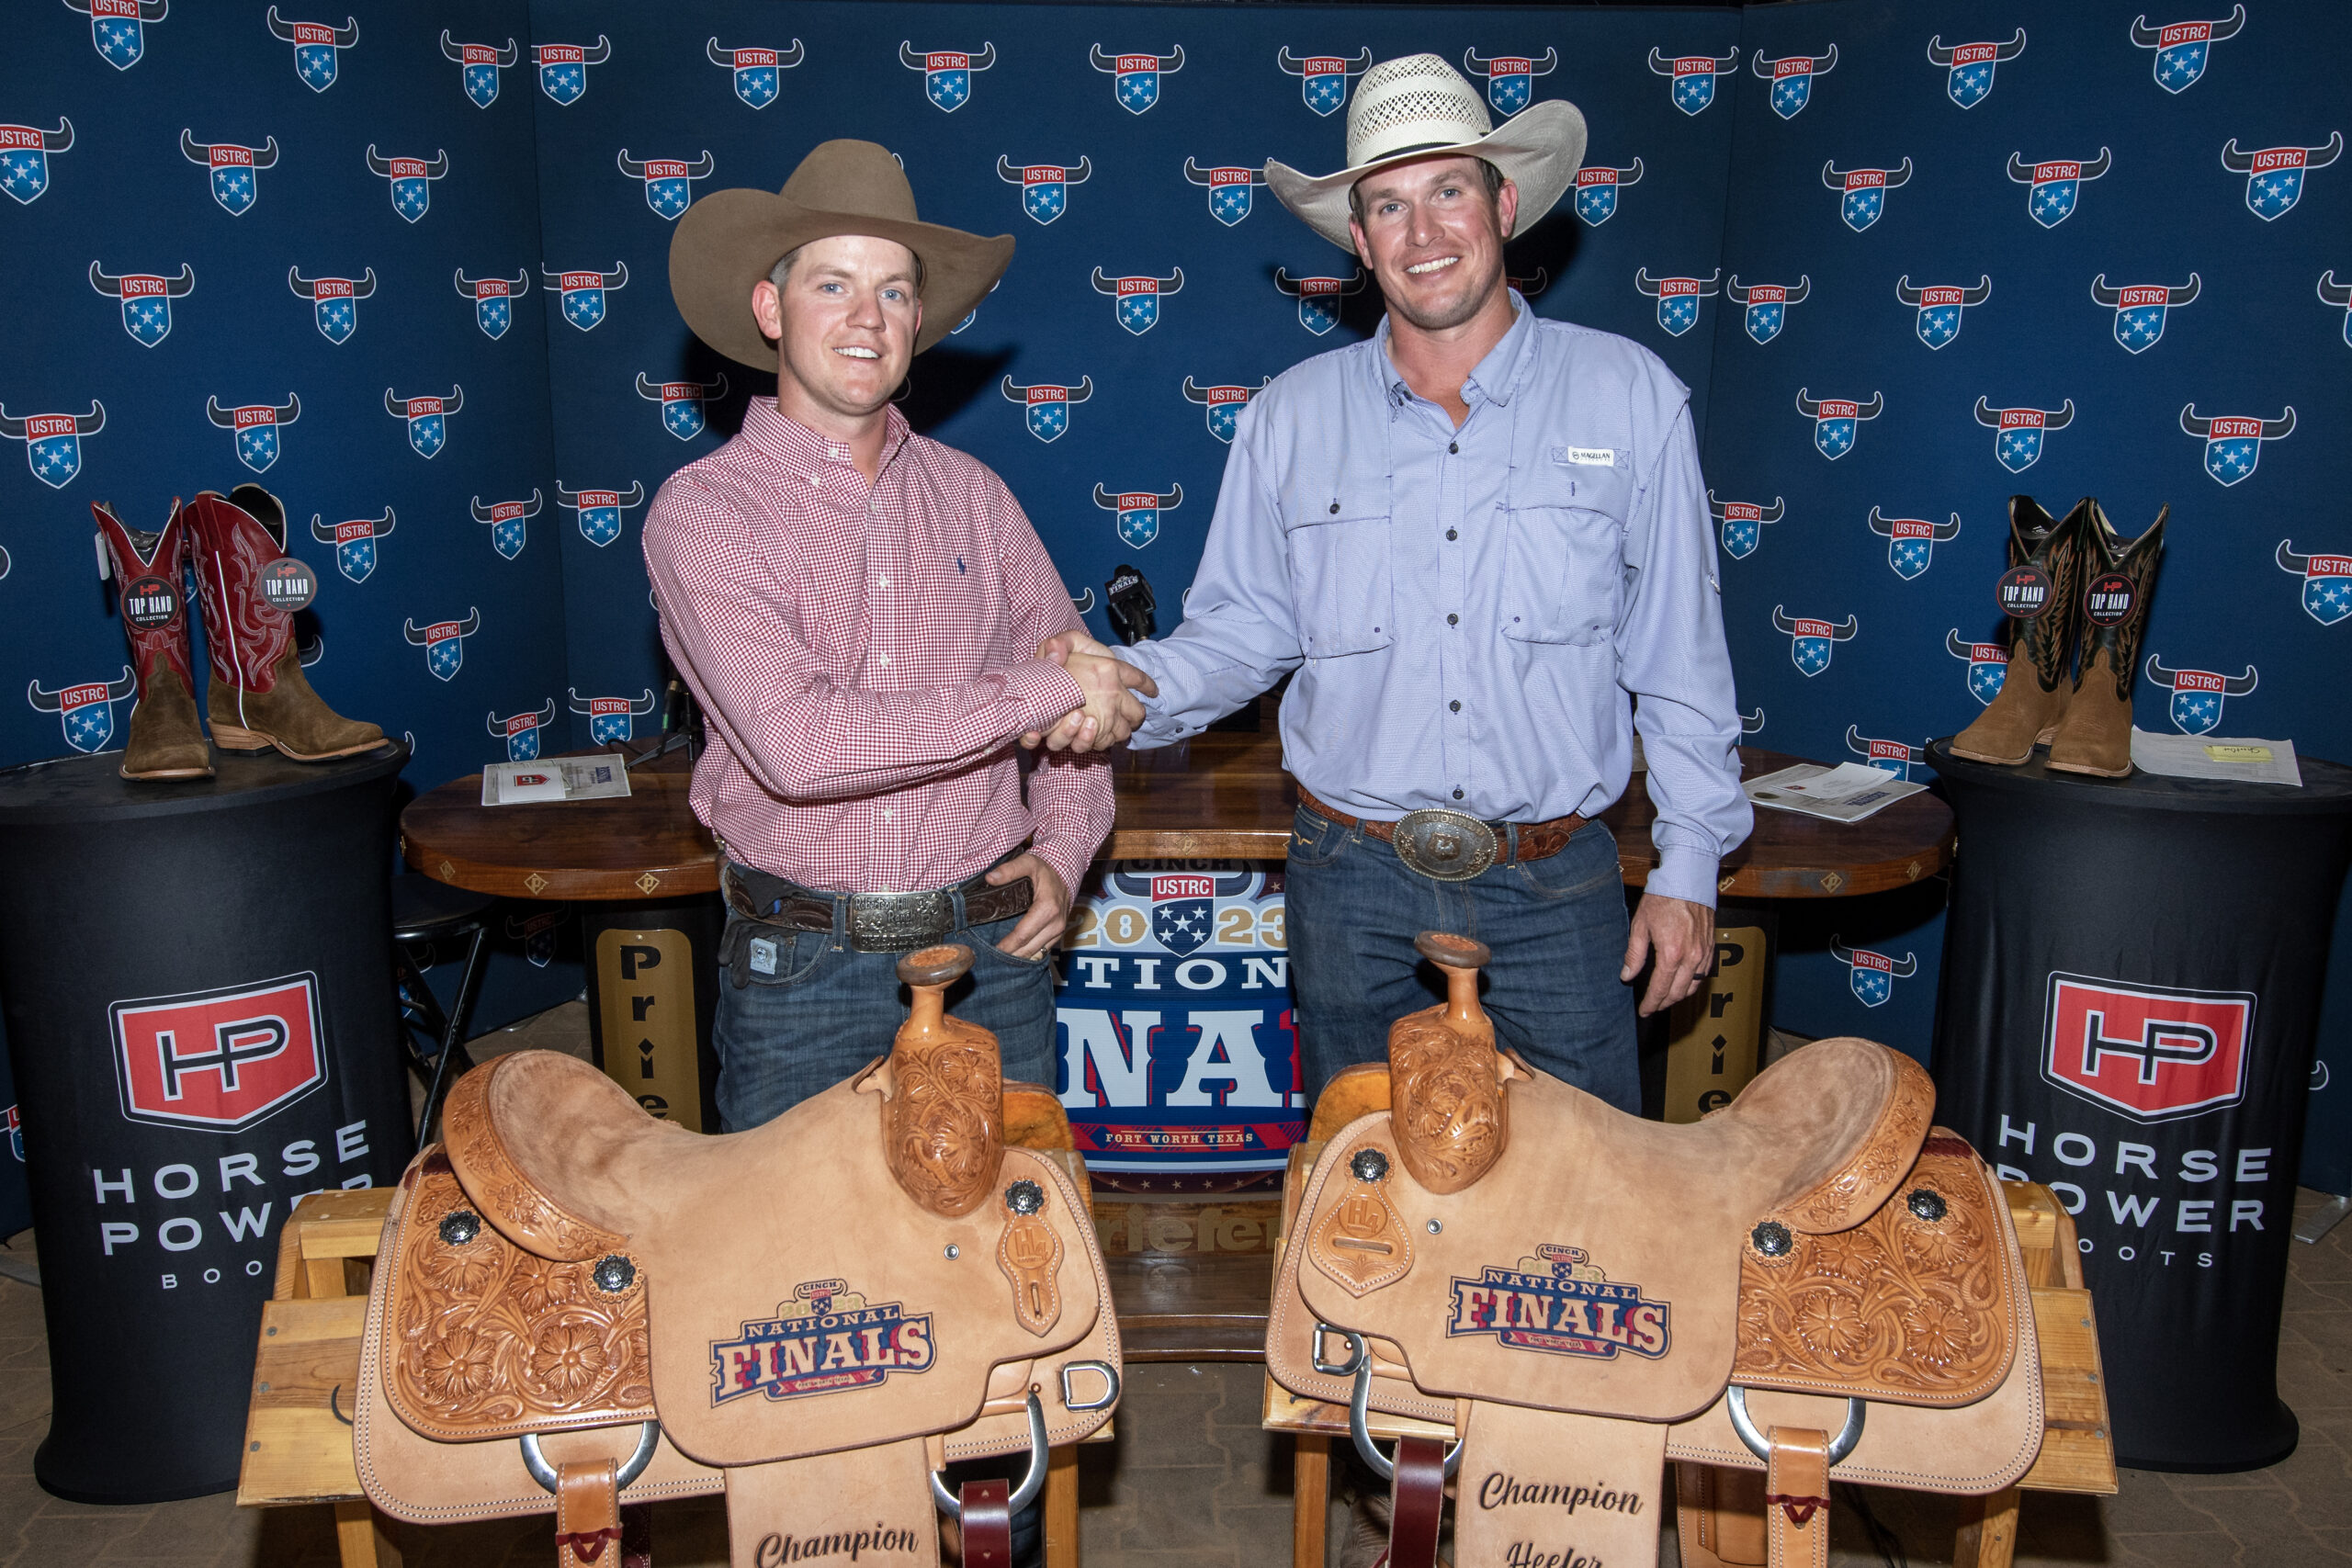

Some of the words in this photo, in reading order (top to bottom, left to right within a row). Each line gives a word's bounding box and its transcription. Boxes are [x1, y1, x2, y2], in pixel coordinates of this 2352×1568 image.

[95, 0, 136, 16] USTRC
[297, 26, 332, 43] USTRC
[2164, 25, 2207, 42] USTRC
[466, 47, 495, 62] USTRC
[543, 48, 581, 61] USTRC
[738, 51, 775, 64] USTRC
[930, 55, 966, 67] USTRC
[1956, 46, 1994, 62] USTRC
[1120, 58, 1155, 70] USTRC
[1307, 61, 1342, 73] USTRC
[1493, 61, 1528, 73] USTRC
[1677, 61, 1712, 73] USTRC
[1777, 61, 1810, 74] USTRC
[212, 148, 250, 164] USTRC
[2256, 152, 2302, 167] USTRC
[393, 162, 424, 175] USTRC
[648, 164, 684, 175] USTRC
[1026, 169, 1062, 181] USTRC
[2037, 164, 2076, 179] USTRC
[1213, 171, 1249, 183] USTRC
[1580, 171, 1615, 183] USTRC
[1849, 173, 1883, 186] USTRC
[124, 279, 164, 294] USTRC
[564, 275, 600, 287] USTRC
[1120, 280, 1155, 292] USTRC
[1304, 281, 1338, 292] USTRC
[1663, 281, 1697, 293] USTRC
[317, 282, 351, 295] USTRC
[479, 283, 507, 295] USTRC
[1751, 288, 1783, 300] USTRC
[1924, 290, 1960, 302] USTRC
[2123, 289, 2165, 303] USTRC
[664, 385, 700, 398] USTRC
[1030, 389, 1065, 400] USTRC
[1211, 389, 1245, 400] USTRC
[410, 400, 440, 413] USTRC
[1822, 403, 1855, 416] USTRC
[237, 410, 273, 423] USTRC
[2004, 412, 2041, 426] USTRC
[29, 418, 73, 434] USTRC
[2214, 421, 2258, 435] USTRC
[581, 493, 616, 505] USTRC
[1121, 496, 1155, 507] USTRC
[494, 504, 522, 518] USTRC
[1727, 505, 1758, 519] USTRC
[338, 524, 371, 538] USTRC
[1895, 522, 1930, 536] USTRC
[266, 579, 282, 595] TOP
[285, 578, 308, 594] HAND
[2004, 586, 2019, 601] TOP
[2021, 586, 2044, 602] HAND
[2090, 593, 2106, 609] TOP
[2107, 593, 2129, 609] HAND
[129, 597, 145, 615] TOP
[149, 595, 172, 614] HAND
[428, 625, 458, 638] USTRC
[1798, 621, 1830, 637] USTRC
[2178, 673, 2221, 690] USTRC
[63, 686, 105, 705] USTRC
[594, 701, 628, 712] USTRC
[509, 715, 536, 731] USTRC
[1872, 742, 1906, 759] USTRC
[1157, 879, 1210, 896] USTRC
[1856, 952, 1889, 970] USTRC
[620, 945, 669, 1118] Prie
[1698, 942, 1744, 1114] Prie
[2080, 1010, 2218, 1086] HP
[155, 1014, 290, 1102] HP
[1105, 1133, 1142, 1143] FORT
[1150, 1134, 1200, 1144] WORTH
[1207, 1133, 1254, 1143] TEXAS
[1998, 1113, 2271, 1183] HORSE
[93, 1119, 369, 1204] HORSE
[101, 1173, 373, 1256] POW
[1545, 1246, 1579, 1256] CINCH
[2077, 1238, 2213, 1268] OOTS
[162, 1260, 263, 1290] BOO
[802, 1281, 837, 1291] CINCH
[1487, 1271, 1636, 1300] NATIONAL
[747, 1307, 899, 1338] NATIONAL
[1454, 1284, 1666, 1353] FINALS
[717, 1320, 930, 1398] FINALS
[1478, 1472, 1645, 1515] Champion
[754, 1521, 920, 1568] Champion
